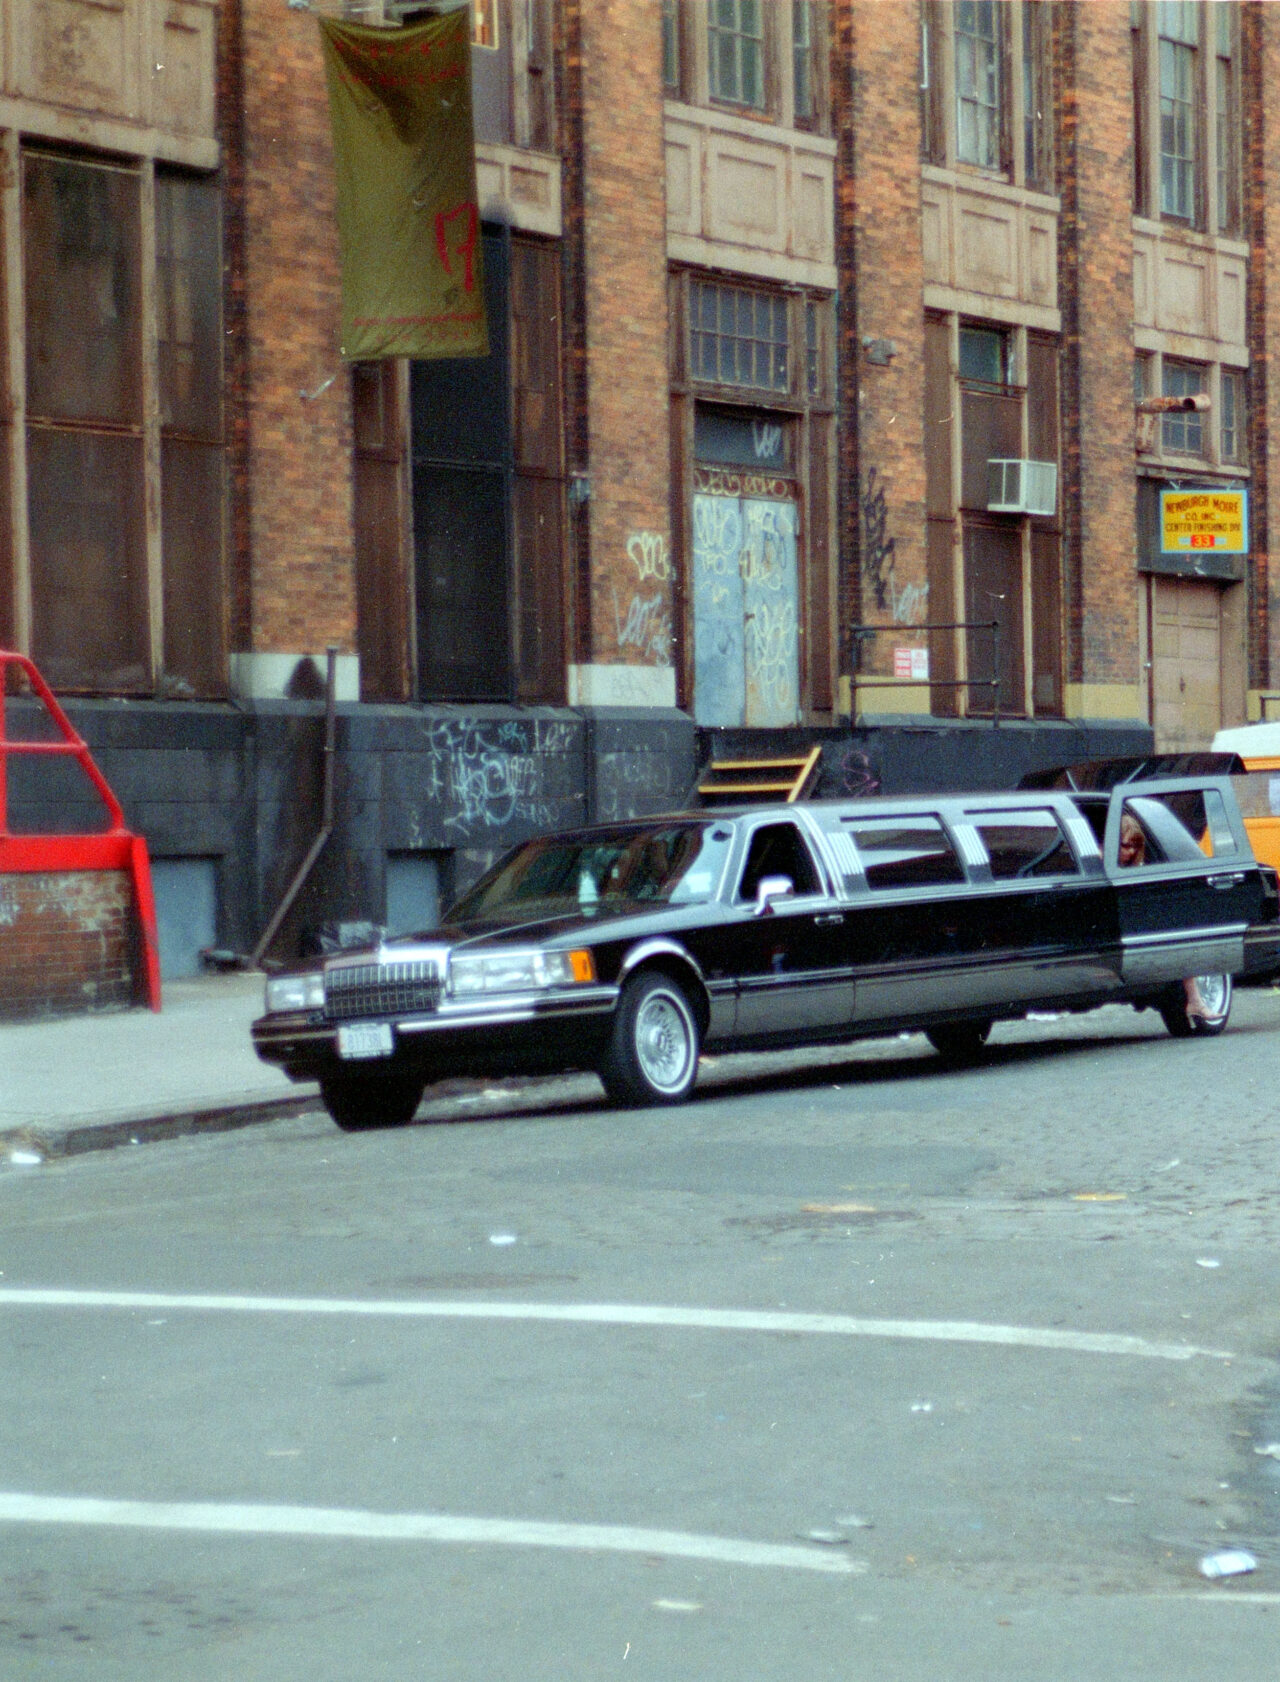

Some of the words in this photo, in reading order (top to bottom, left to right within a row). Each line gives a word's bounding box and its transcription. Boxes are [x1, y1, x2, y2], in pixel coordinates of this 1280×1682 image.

[1166, 496, 1209, 513] NEWBURGH
[1213, 499, 1239, 513] MOIRE
[1166, 523, 1192, 532] CENTER
[1194, 523, 1227, 532] FINISHING
[1194, 535, 1210, 547] 33
